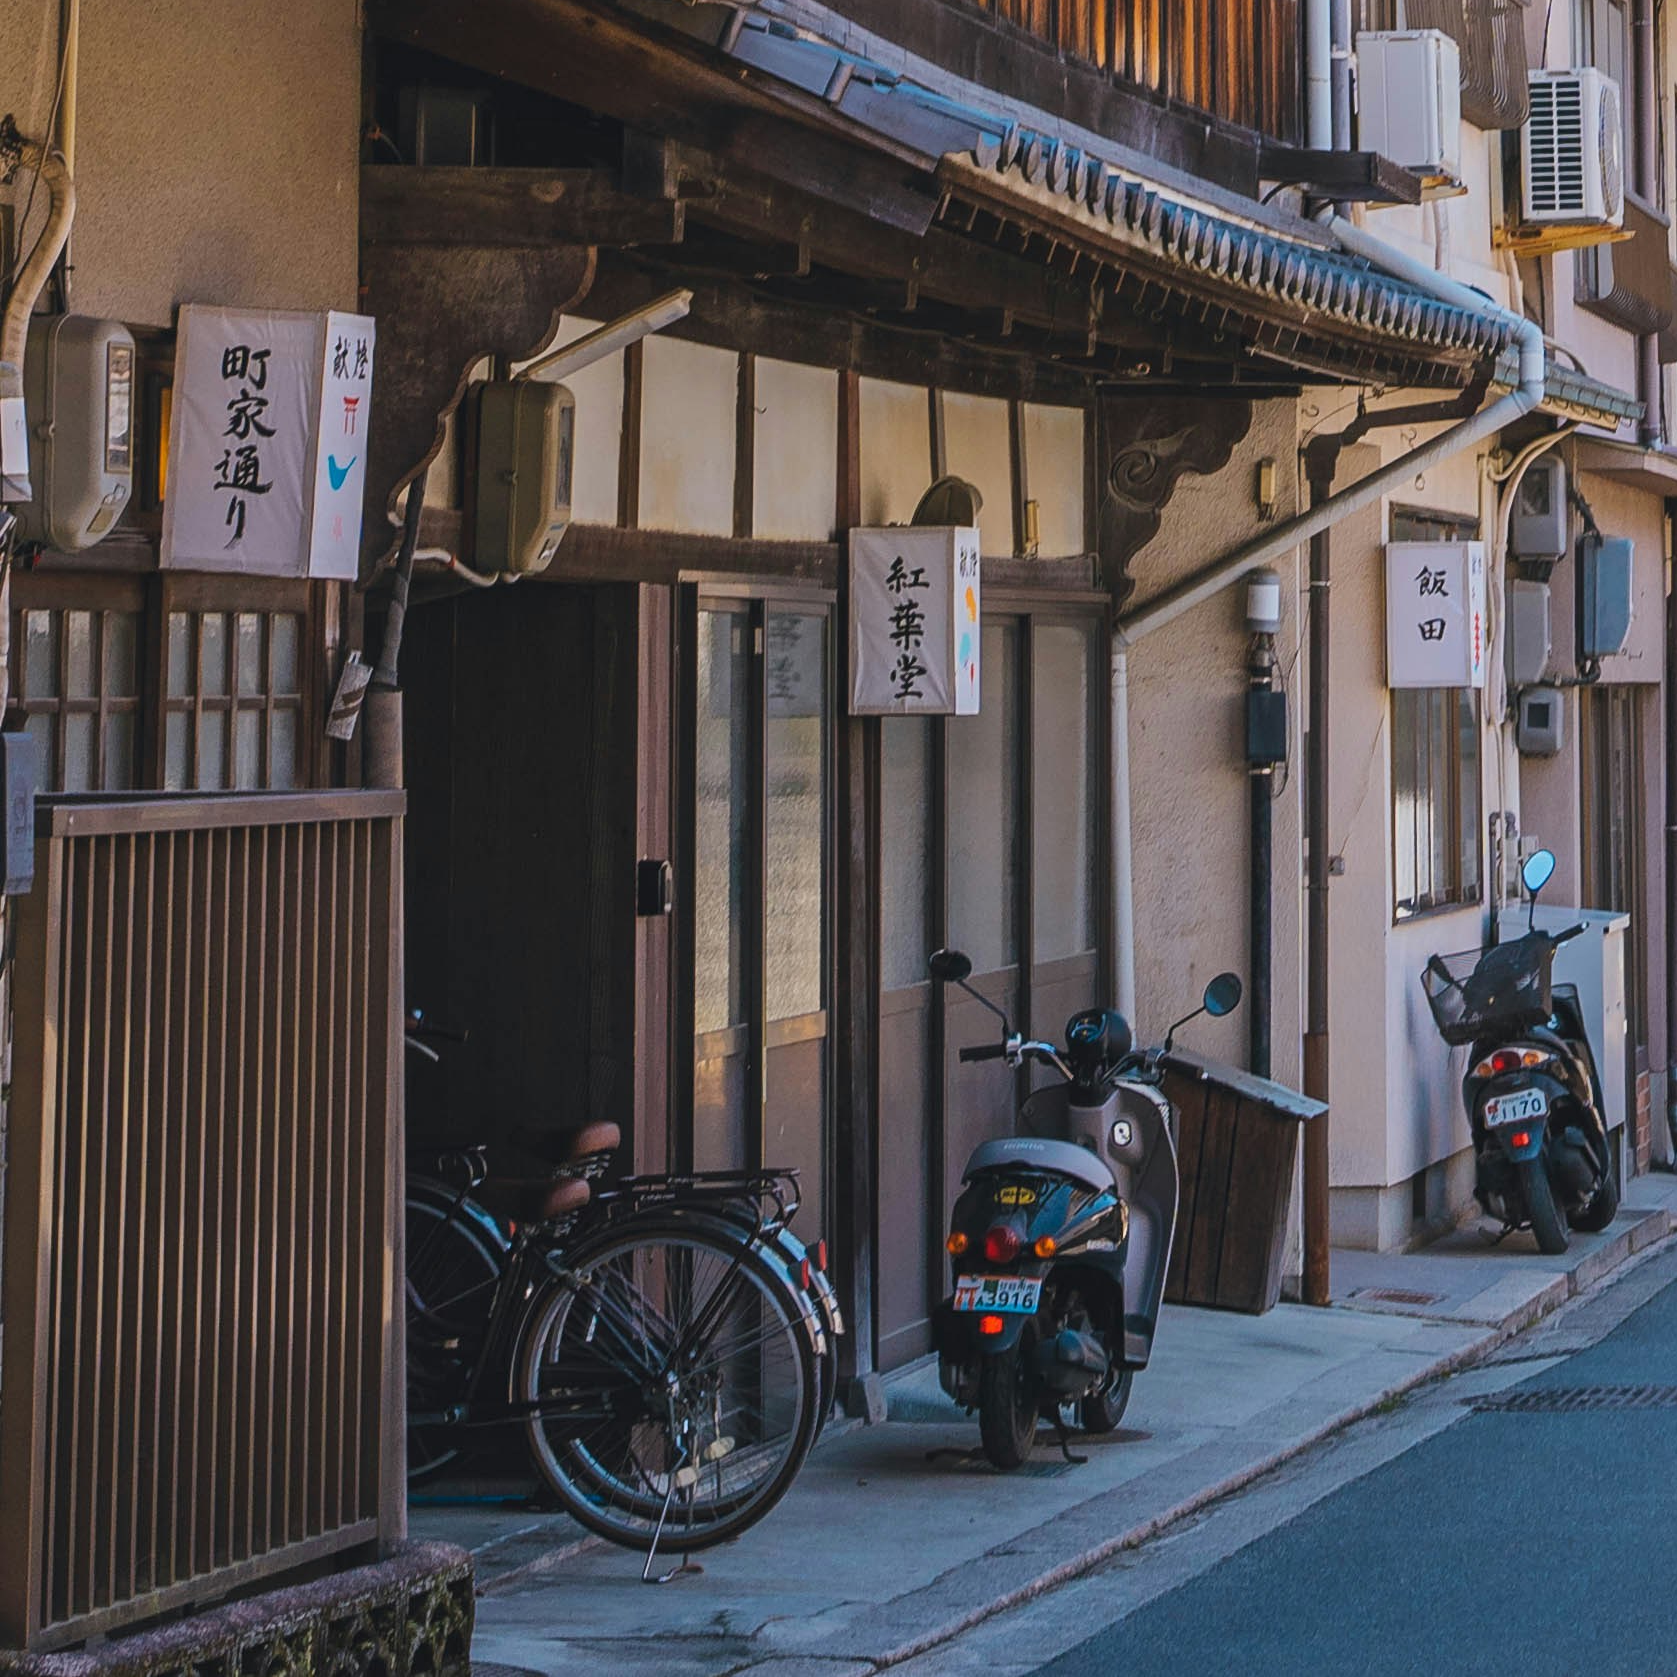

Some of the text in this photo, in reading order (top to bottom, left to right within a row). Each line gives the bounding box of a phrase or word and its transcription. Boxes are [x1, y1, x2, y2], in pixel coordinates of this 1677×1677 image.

[213, 344, 277, 550] 町家通り
[885, 555, 930, 699] 紅葉堂
[1414, 565, 1450, 642] 飯田
[985, 1291, 1034, 1309] 3916
